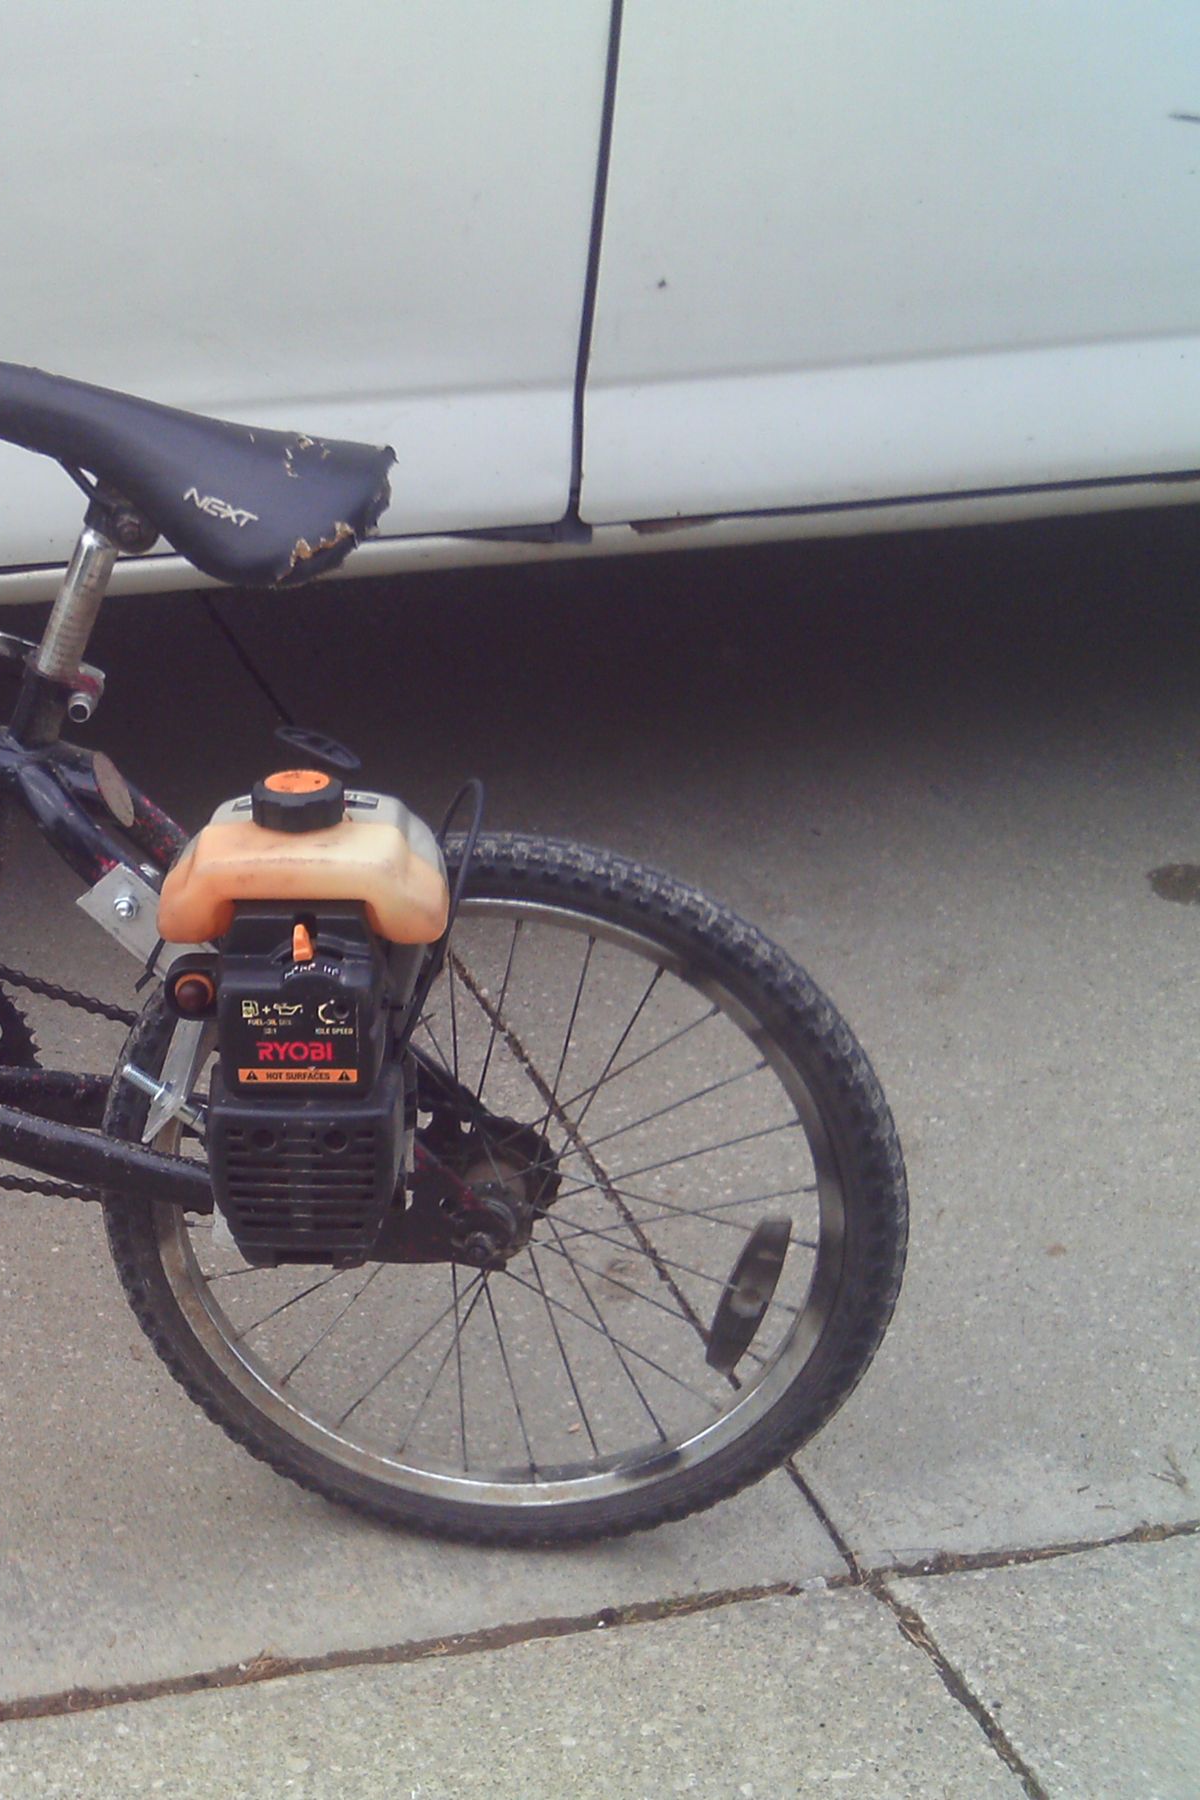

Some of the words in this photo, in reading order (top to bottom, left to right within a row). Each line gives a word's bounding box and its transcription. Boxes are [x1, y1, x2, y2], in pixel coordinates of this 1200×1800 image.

[183, 487, 259, 527] NEXT
[256, 1041, 335, 1061] RYOBI
[265, 1071, 283, 1081] HOT
[285, 1071, 331, 1081] SURFACES
